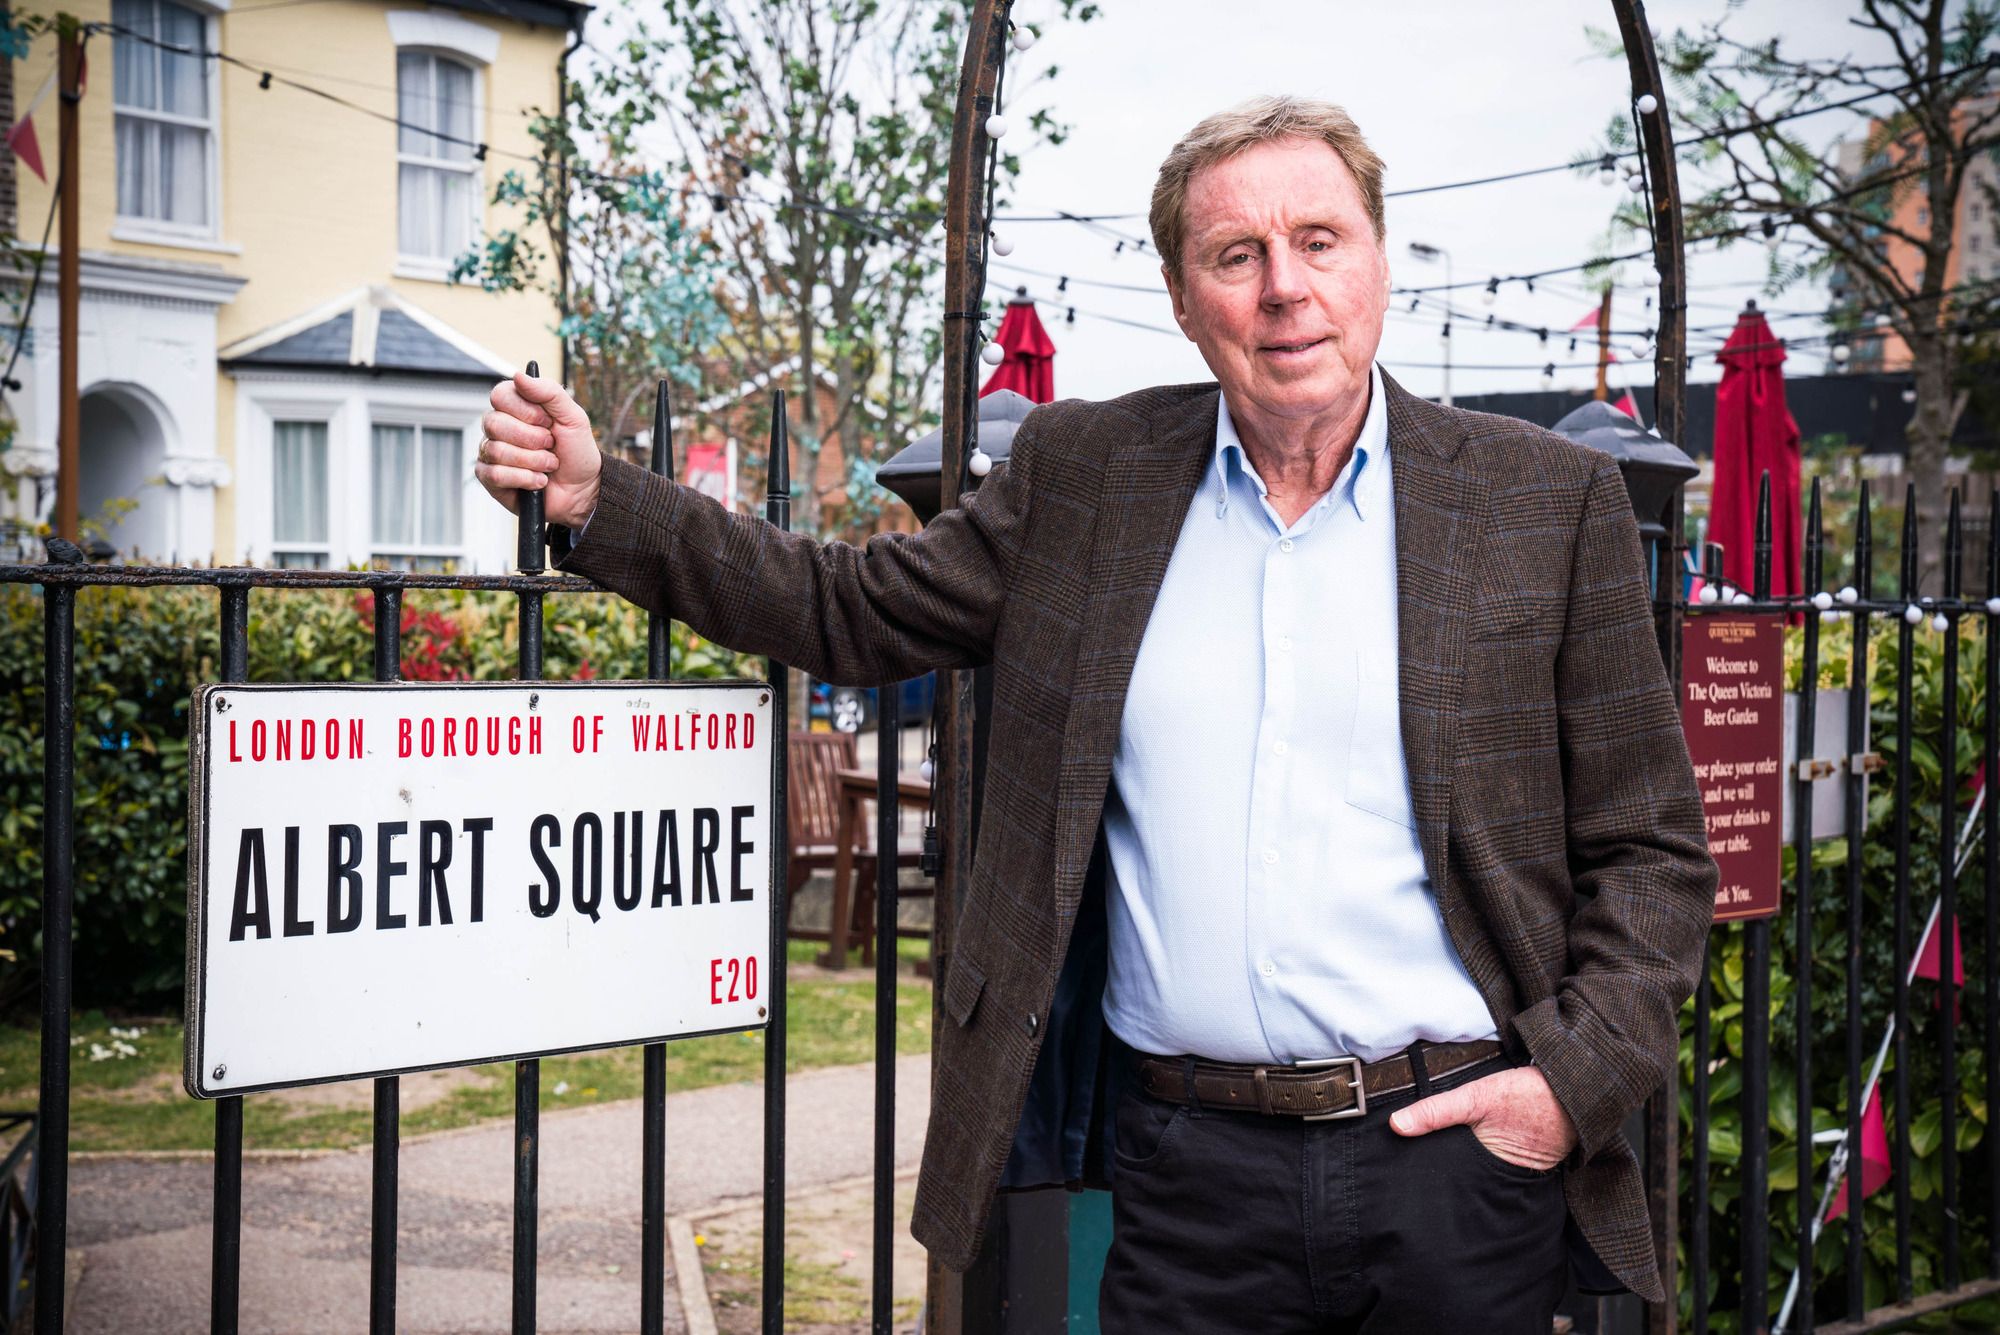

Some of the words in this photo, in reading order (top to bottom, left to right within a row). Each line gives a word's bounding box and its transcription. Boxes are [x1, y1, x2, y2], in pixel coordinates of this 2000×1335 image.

[1706, 656, 1748, 674] Welcome
[1749, 659, 1759, 673] to
[1688, 682, 1708, 700] The
[1708, 681, 1739, 704] Queen
[1740, 681, 1772, 699] Victoria
[1704, 708, 1726, 726] Beer
[1727, 706, 1759, 725] Garden
[229, 718, 364, 763] LONDON
[399, 715, 542, 759] BOROUGH
[572, 714, 605, 754] OF
[632, 712, 756, 753] WALFORD
[1710, 759, 1734, 782] place
[1734, 762, 1755, 780] your
[1755, 756, 1777, 775] order
[1704, 785, 1722, 803] and
[1723, 788, 1736, 802] we
[1737, 782, 1755, 800] will
[1711, 813, 1733, 833] your
[1733, 807, 1760, 827] drinks
[1761, 810, 1771, 825] to
[1727, 834, 1752, 853] table.
[229, 817, 494, 942] ALBERT
[528, 805, 755, 924] SQUARE
[1732, 885, 1753, 903] You.
[710, 955, 758, 1006] E20
